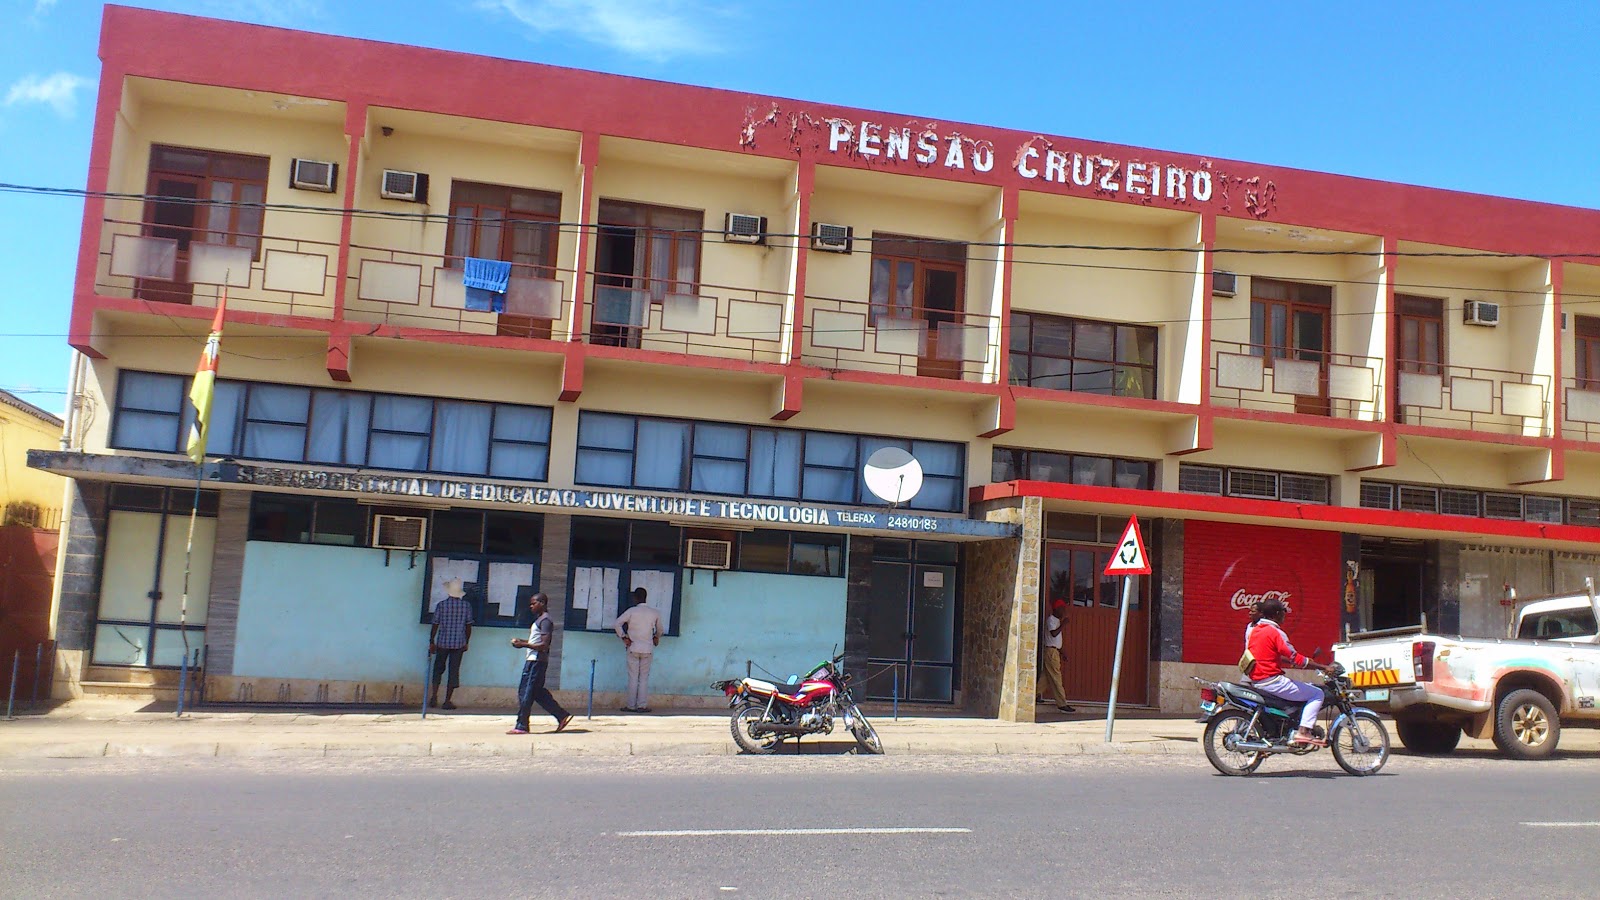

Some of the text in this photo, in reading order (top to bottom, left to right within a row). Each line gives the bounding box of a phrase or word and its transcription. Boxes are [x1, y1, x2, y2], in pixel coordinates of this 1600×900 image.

[1018, 146, 1213, 202] CRUZEIRO
[441, 481, 467, 499] DE
[584, 492, 696, 515] JUVENTUDE
[700, 499, 711, 516] E
[718, 501, 830, 525] TECNOLOGIA
[836, 511, 876, 523] TELEFAX
[887, 516, 938, 530] 24810183
[1353, 657, 1393, 673] ISUZU
